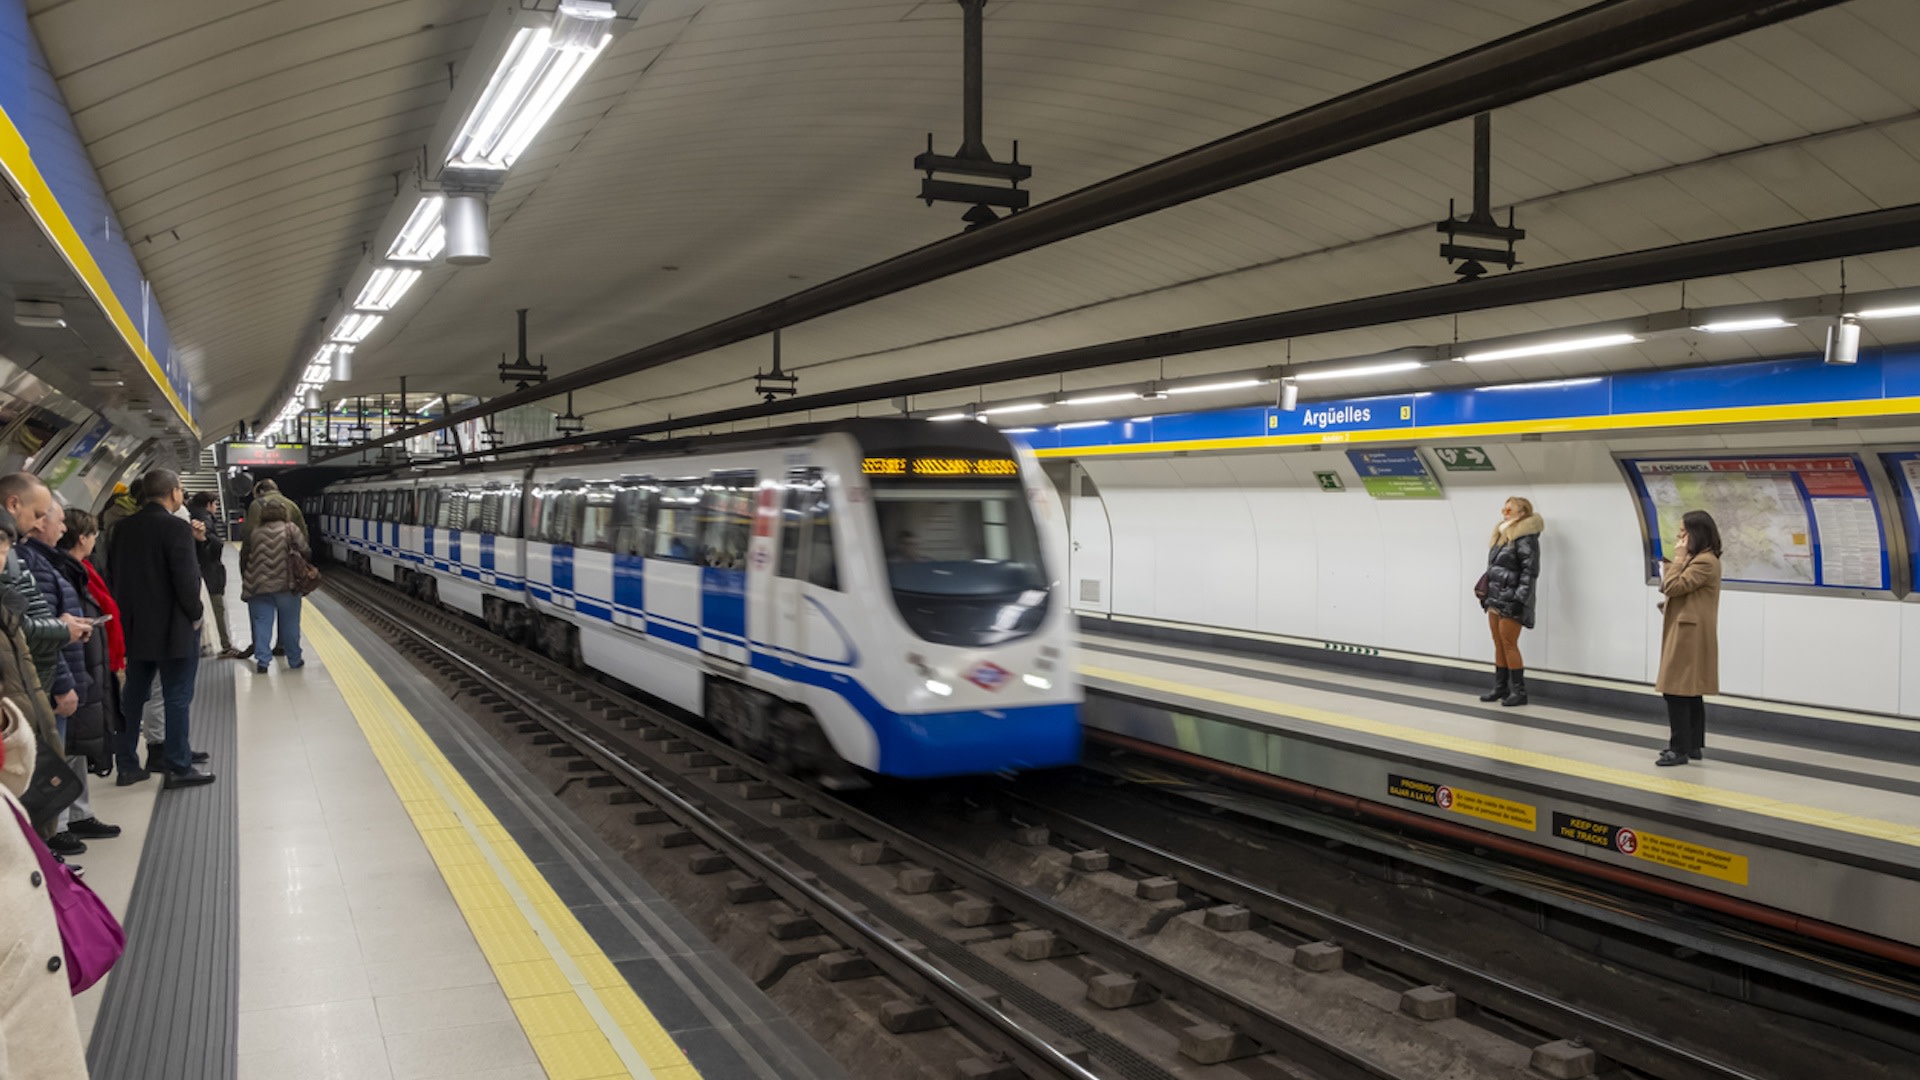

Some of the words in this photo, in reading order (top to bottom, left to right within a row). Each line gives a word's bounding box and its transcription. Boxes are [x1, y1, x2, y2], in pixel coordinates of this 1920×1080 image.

[1303, 406, 1371, 428] Argüelles
[1390, 786, 1409, 797] BAJAR
[1416, 792, 1424, 800] LA
[1401, 779, 1435, 793] PROHIBIDO
[1570, 818, 1590, 830] KEEP
[1592, 823, 1608, 834] OFF
[1560, 827, 1576, 838] THE
[1577, 831, 1608, 846] TRACKS
